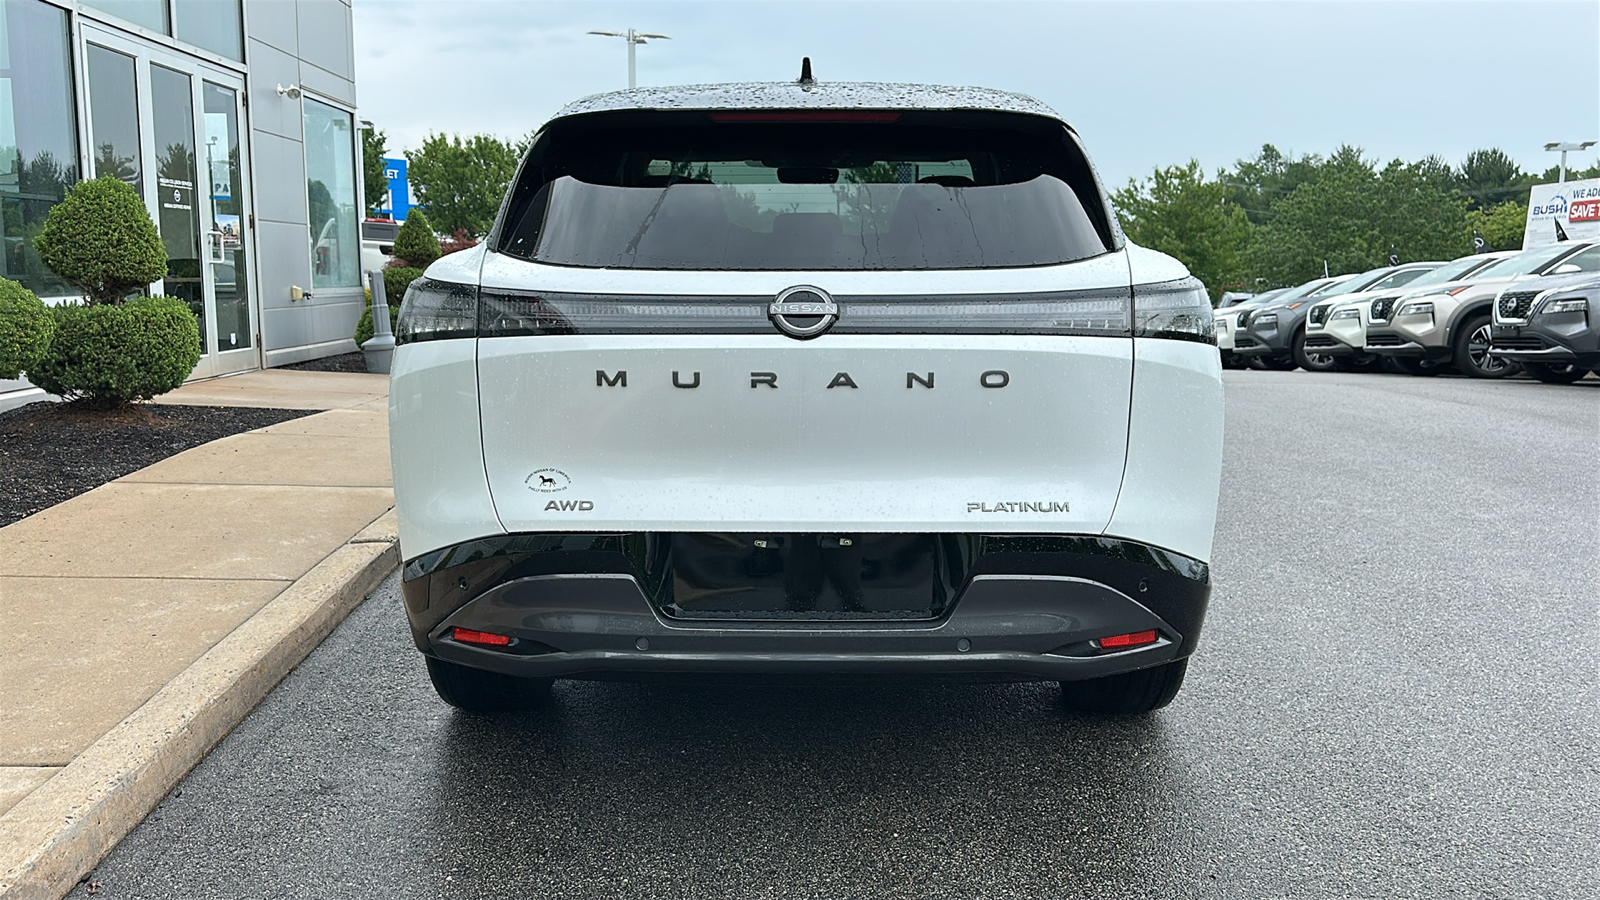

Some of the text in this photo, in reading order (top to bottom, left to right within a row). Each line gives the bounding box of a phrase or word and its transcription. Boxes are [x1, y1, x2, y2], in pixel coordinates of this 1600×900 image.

[1573, 189, 1586, 199] WE
[1533, 204, 1564, 215] BUSH
[1570, 203, 1596, 219] SAVE
[771, 304, 836, 312] NISSAN
[595, 369, 1011, 389] MURANO
[544, 500, 594, 511] AWD
[967, 501, 1070, 513] PLATINUM
